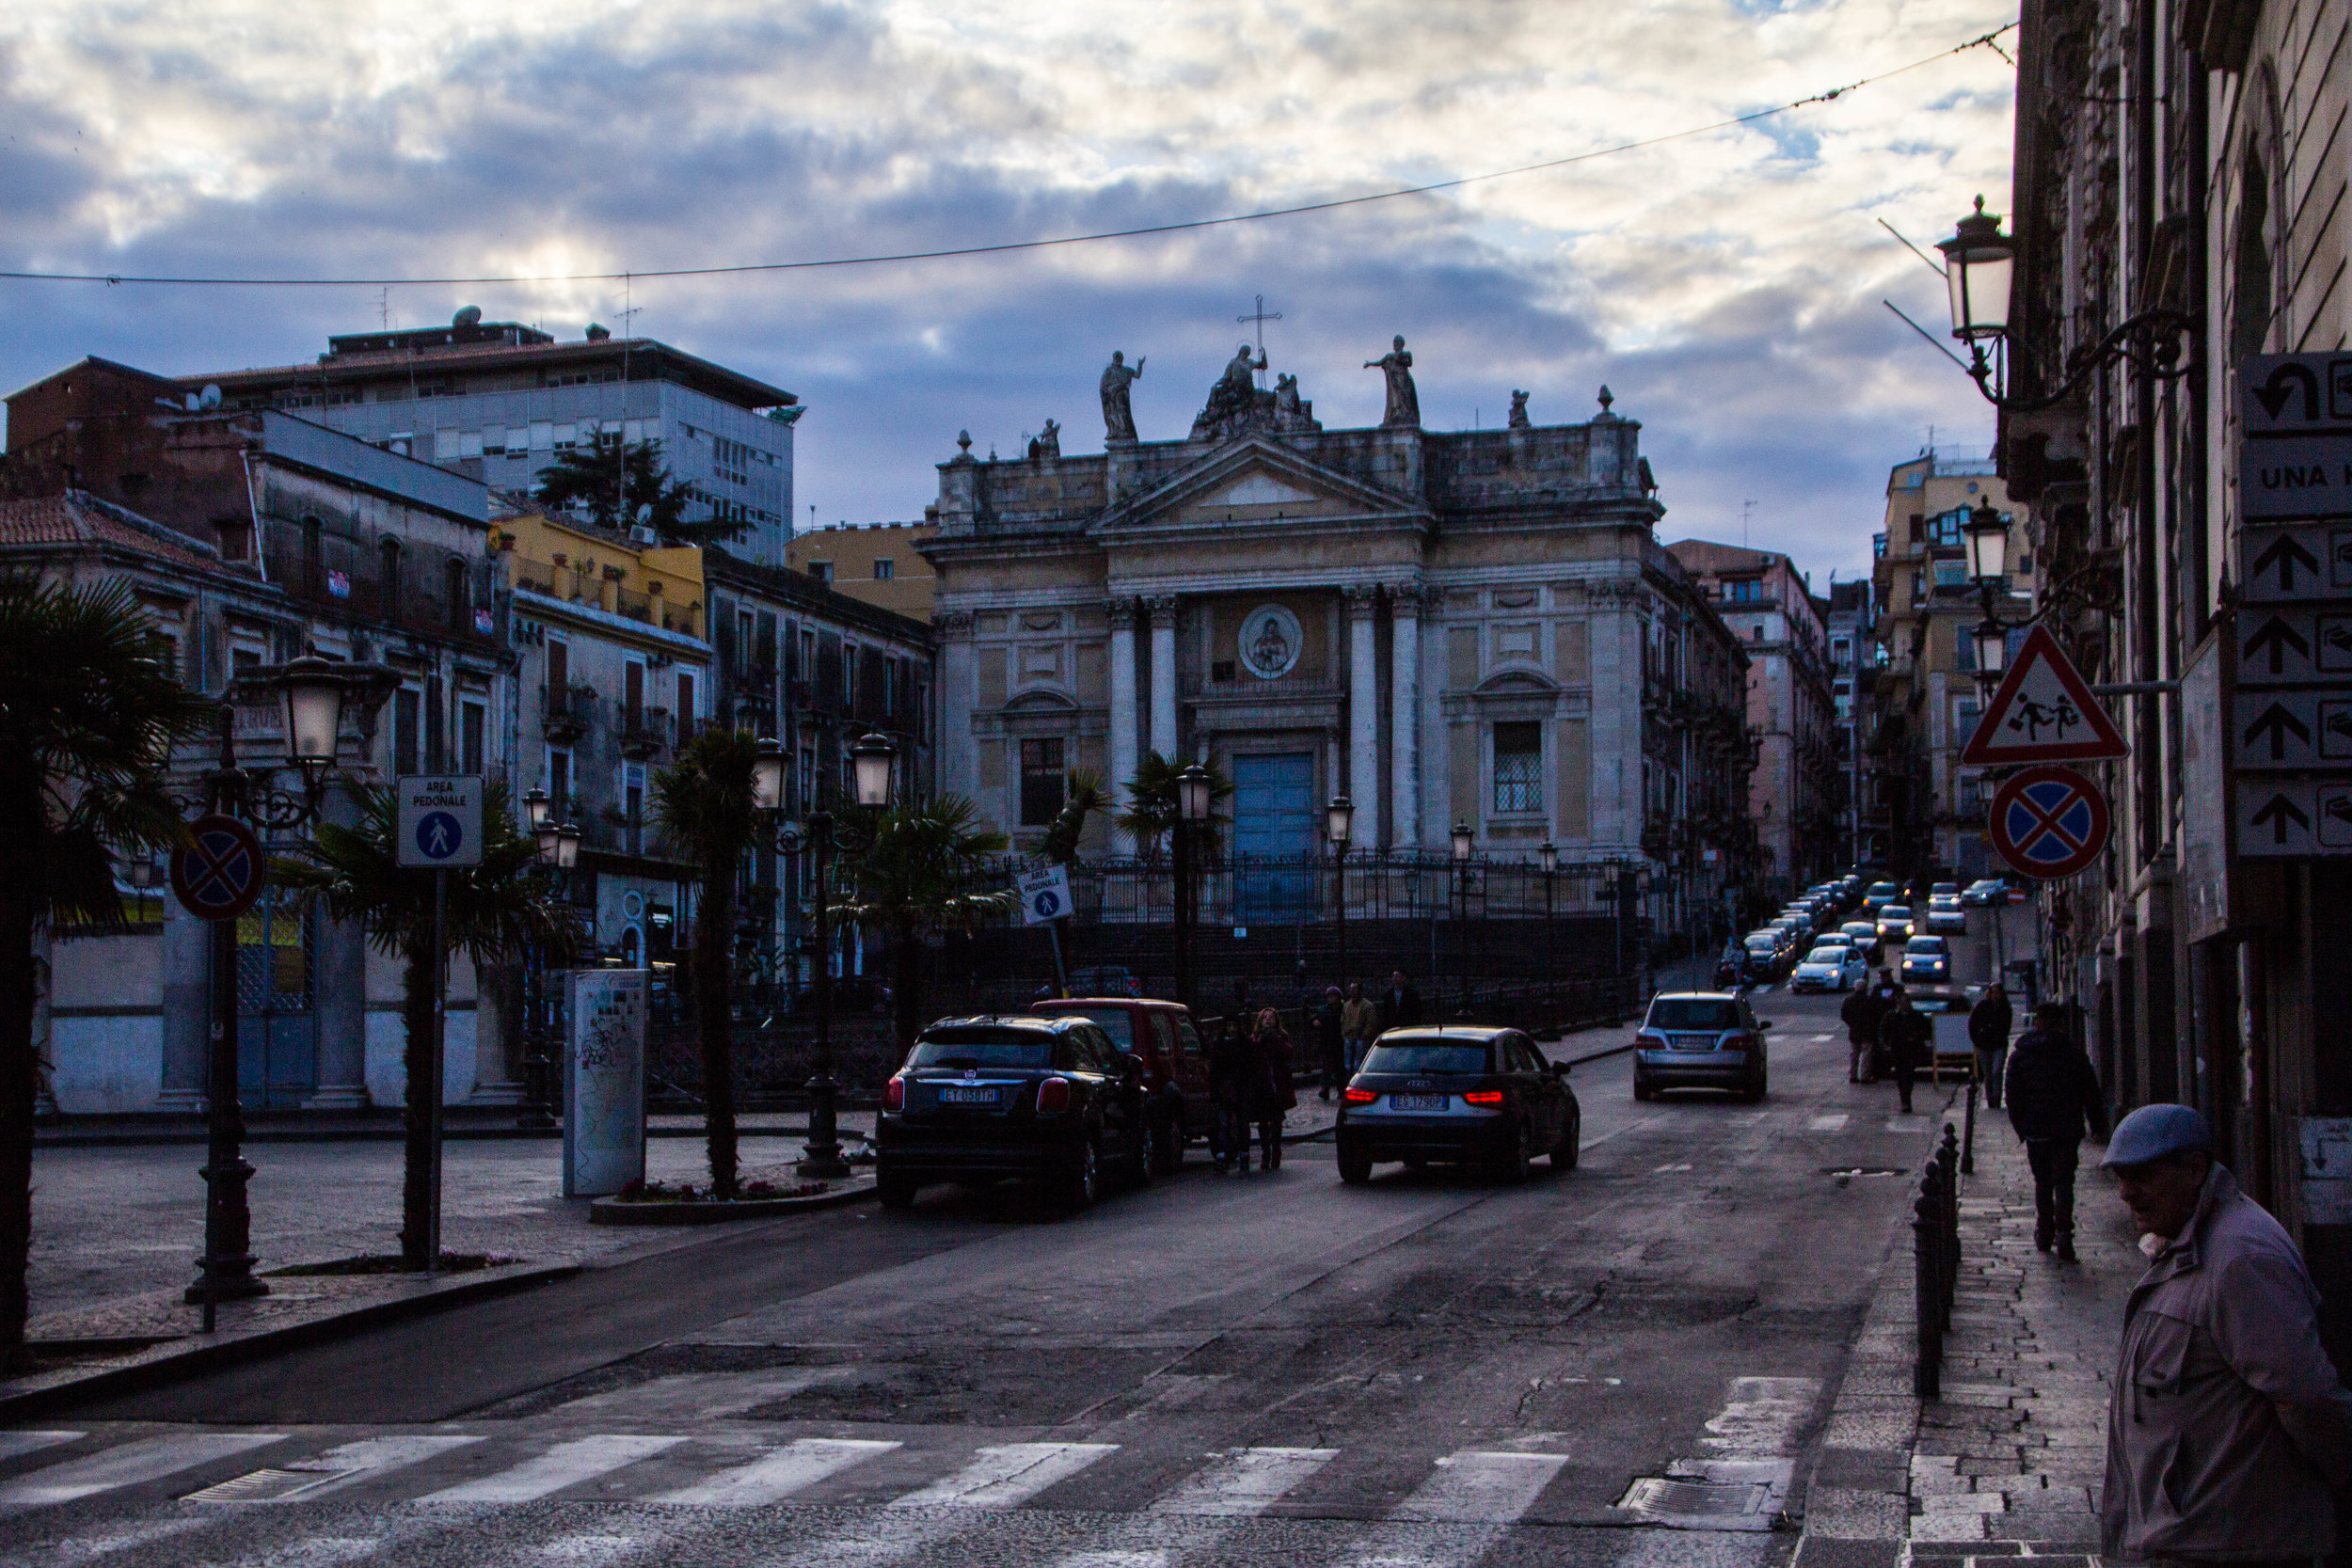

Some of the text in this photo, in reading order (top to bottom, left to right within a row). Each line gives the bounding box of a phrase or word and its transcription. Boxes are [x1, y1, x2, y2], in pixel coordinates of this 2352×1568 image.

[2262, 466, 2328, 489] UNA
[426, 782, 453, 792] AREA
[413, 796, 467, 806] PEDONALE
[1031, 869, 1050, 880] AREA
[1024, 877, 1060, 892] PEDONALE
